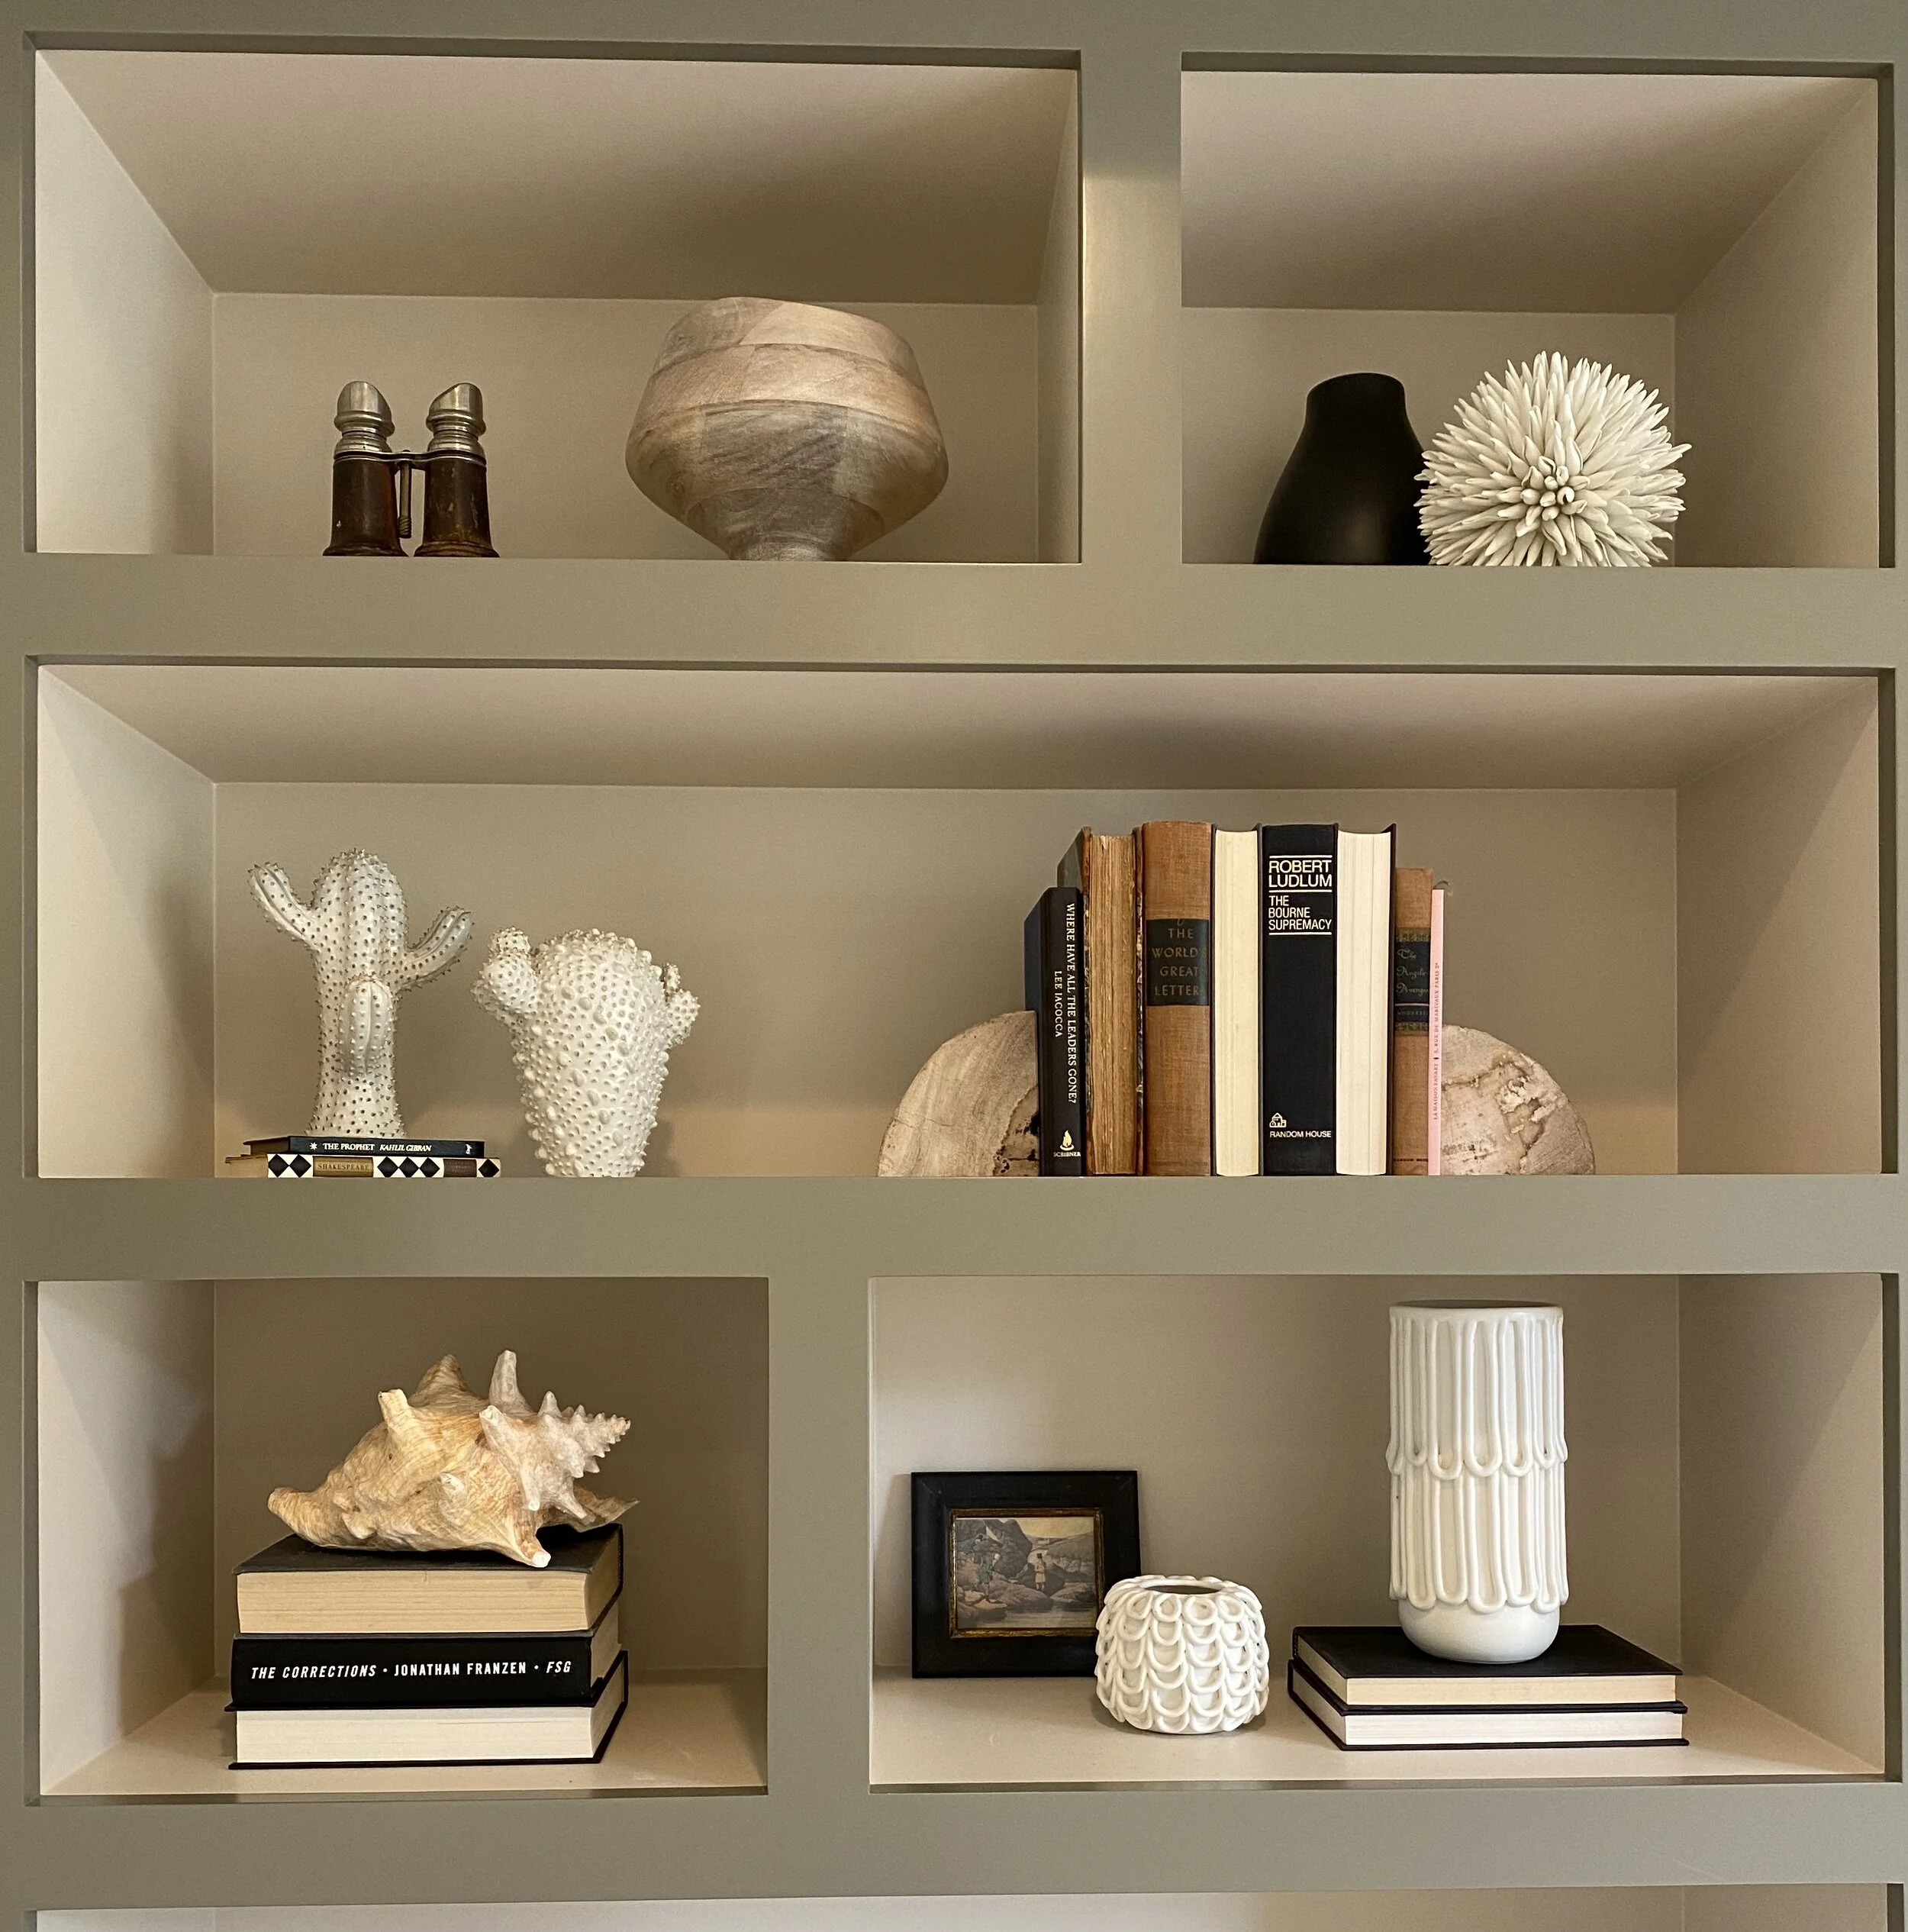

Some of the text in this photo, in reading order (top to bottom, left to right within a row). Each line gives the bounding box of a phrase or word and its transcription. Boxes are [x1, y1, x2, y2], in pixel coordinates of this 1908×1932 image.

[1268, 860, 1333, 874] ROBERT
[1268, 873, 1333, 888] LUDLUM
[1268, 895, 1290, 907] THE
[1268, 907, 1311, 919] BOURNE
[1268, 918, 1333, 931] SUPREMACY
[1168, 928, 1194, 940] THE
[1397, 948, 1417, 960] The
[1159, 966, 1201, 977] GREAT
[1154, 984, 1204, 996] LETTER
[1054, 971, 1063, 1037] LEE IACOCCA
[1066, 903, 1077, 1104] WHERE HAVE ALL THE LEADERS GONE?
[1434, 1024, 1439, 1033] DE
[322, 1143, 340, 1151] THE
[340, 1143, 375, 1152] PROPHET
[379, 1143, 405, 1152] KAHLIL
[251, 1660, 572, 1679] THE CORRECTIONS JONATHAN FRANZEN FSG
